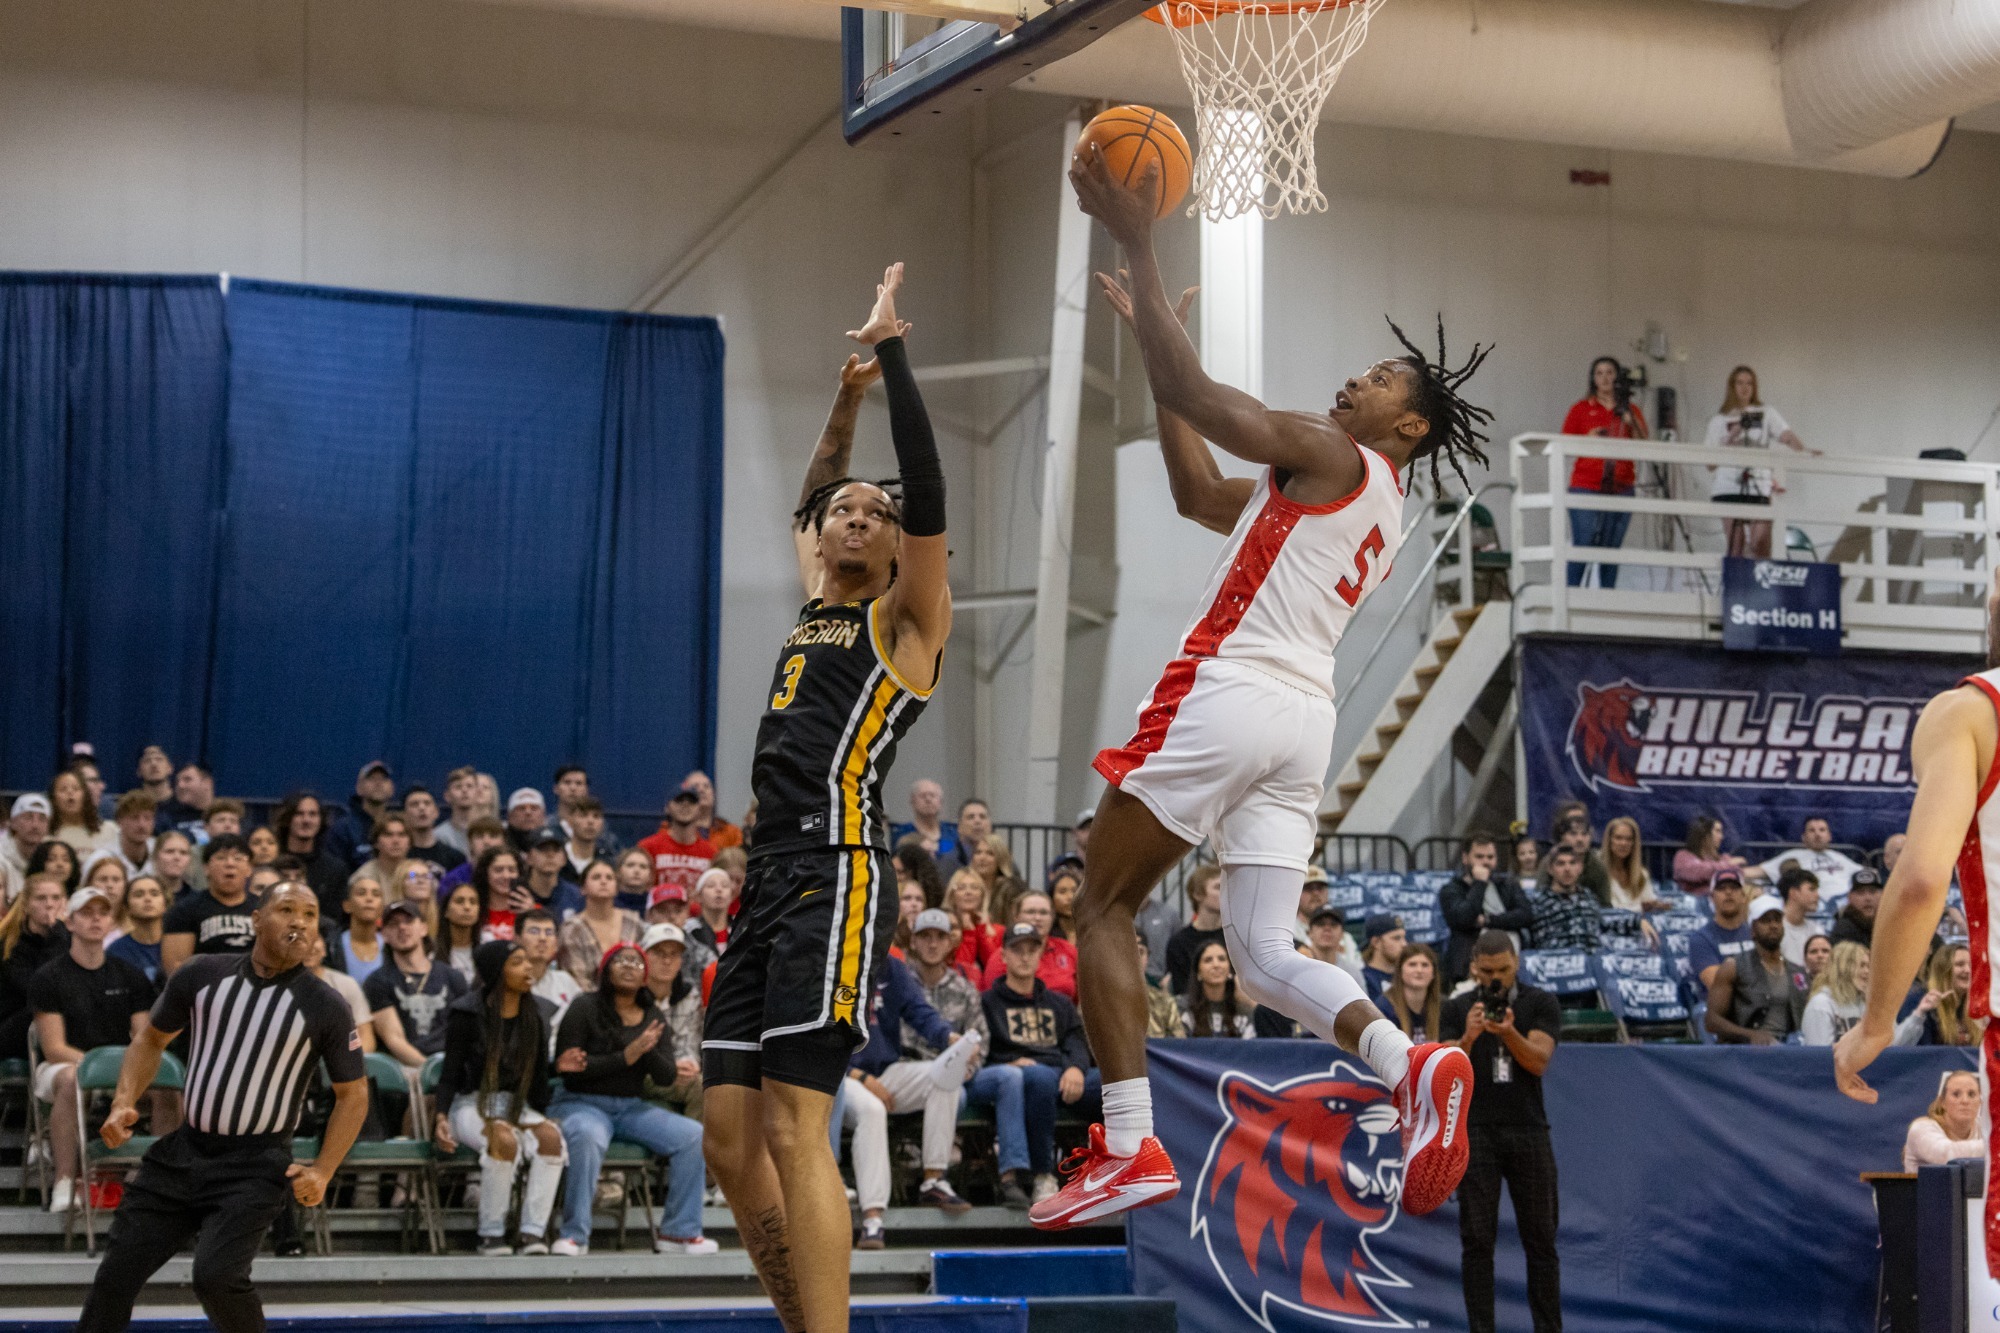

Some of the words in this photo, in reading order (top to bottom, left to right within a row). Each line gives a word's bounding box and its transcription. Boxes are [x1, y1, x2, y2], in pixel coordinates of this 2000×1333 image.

[1334, 523, 1394, 608] 5
[785, 619, 861, 649] MERON
[1730, 604, 1813, 629] Section
[1819, 609, 1836, 630] H
[772, 653, 807, 710] 3
[1645, 698, 1922, 750] HILLCA
[1635, 745, 1919, 784] BASKETBAL
